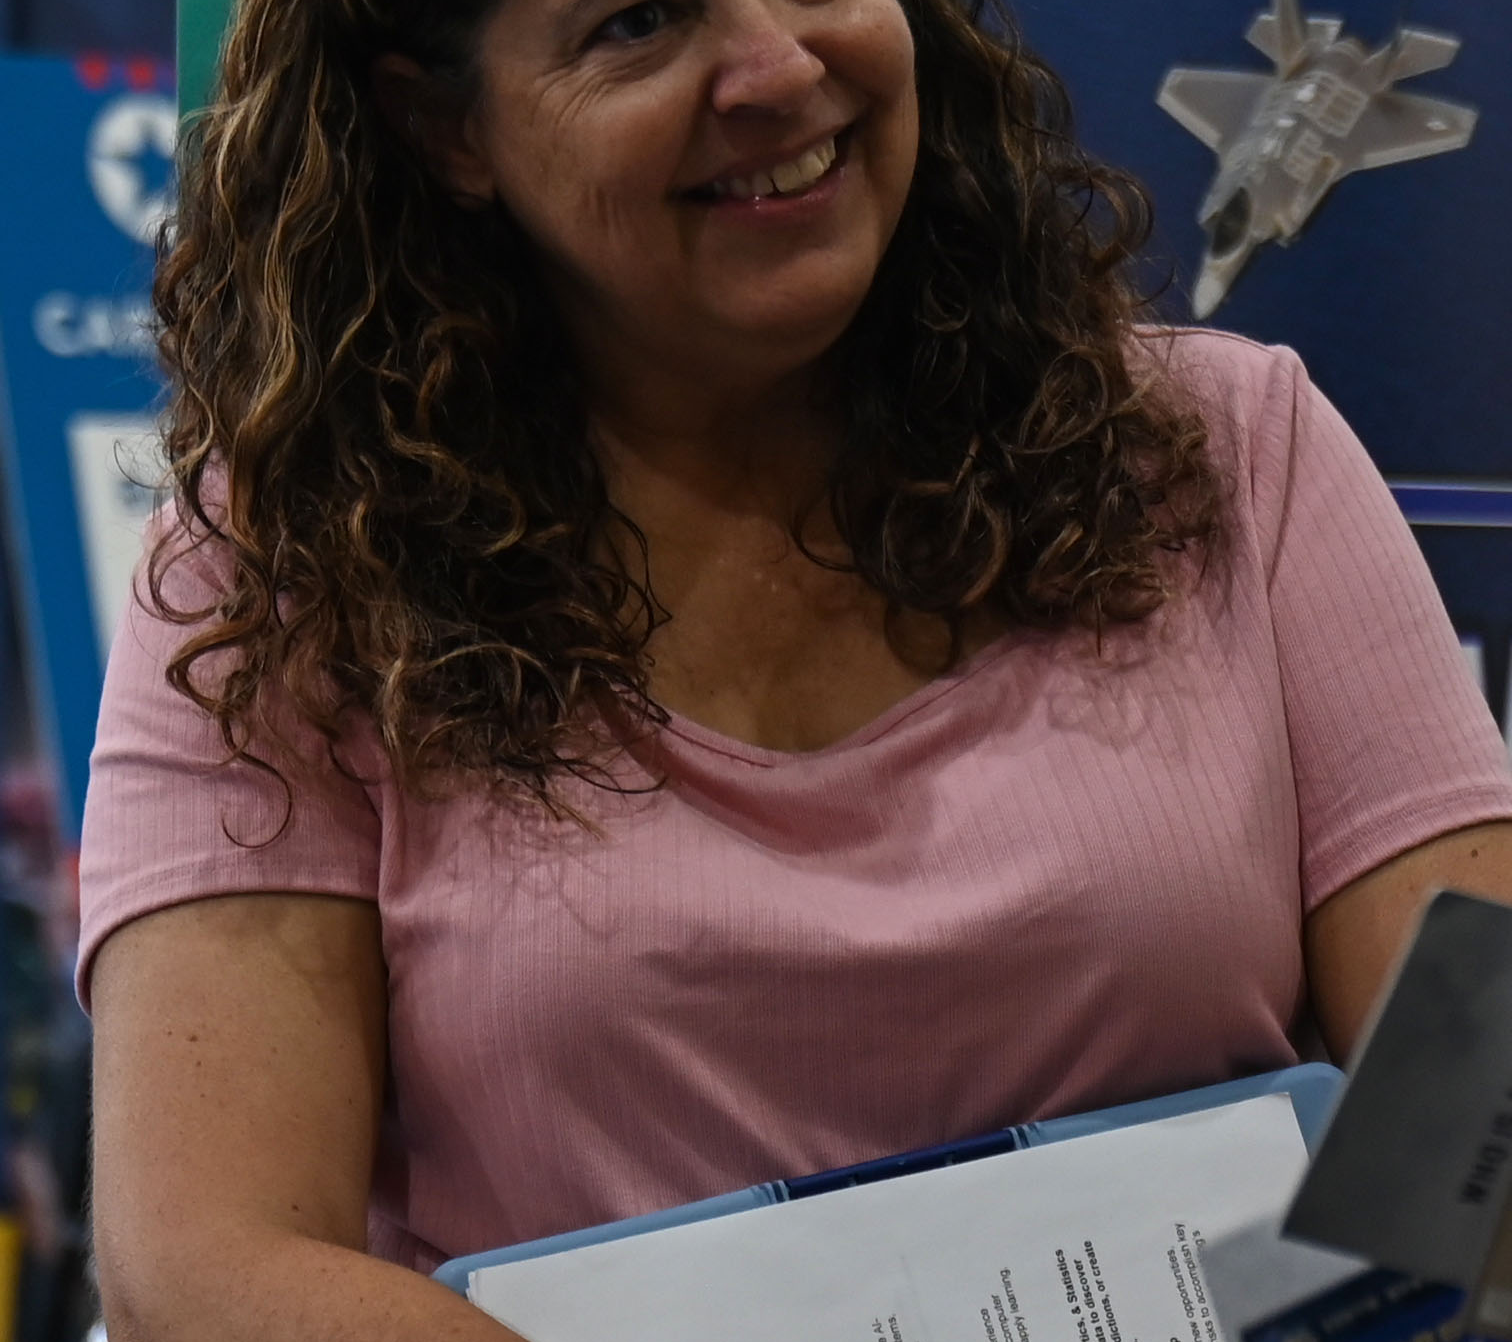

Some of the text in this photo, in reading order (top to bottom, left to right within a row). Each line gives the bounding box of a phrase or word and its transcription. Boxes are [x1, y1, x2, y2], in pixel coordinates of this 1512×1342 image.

[1454, 1139, 1507, 1213] WHO
[1174, 1223, 1187, 1243] key
[1055, 1249, 1078, 1304] Statistics
[1083, 1240, 1101, 1277] create
[1180, 1243, 1206, 1304] accomplish
[1000, 1267, 1020, 1314] learning.
[1073, 1259, 1096, 1309] discover
[1095, 1279, 1106, 1292] or
[1167, 1246, 1196, 1319] opportunities,
[1070, 1305, 1082, 1315] &
[1090, 1311, 1100, 1324] to
[1200, 1306, 1210, 1319] to
